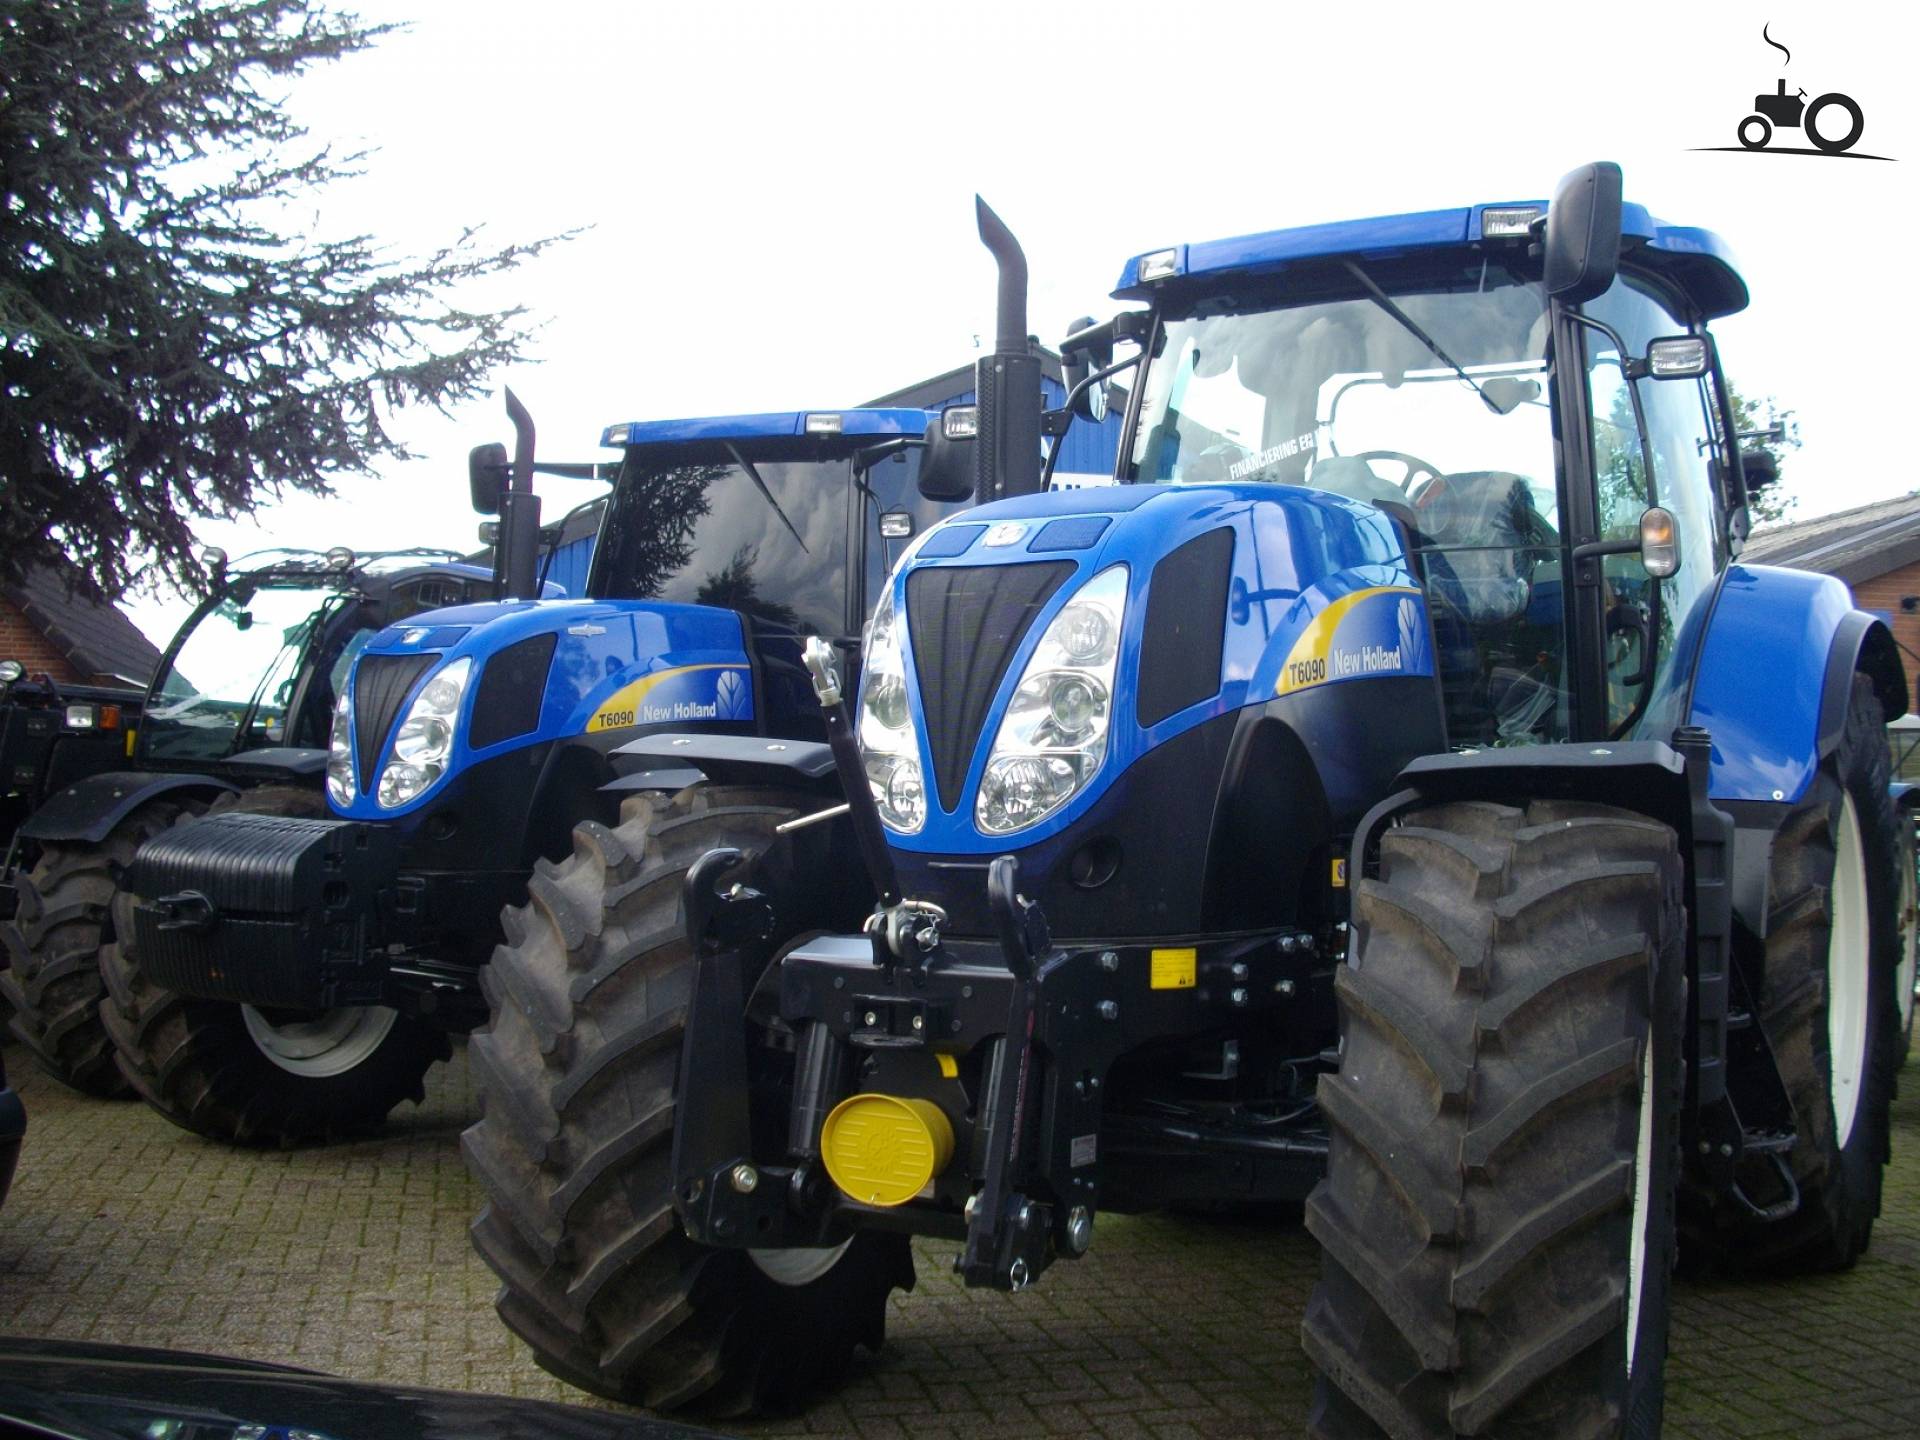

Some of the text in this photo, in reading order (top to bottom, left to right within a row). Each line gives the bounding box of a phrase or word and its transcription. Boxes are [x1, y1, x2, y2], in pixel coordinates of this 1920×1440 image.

[1289, 645, 1401, 685] T6090 New Holland
[599, 702, 716, 727] T6090 New Holland
